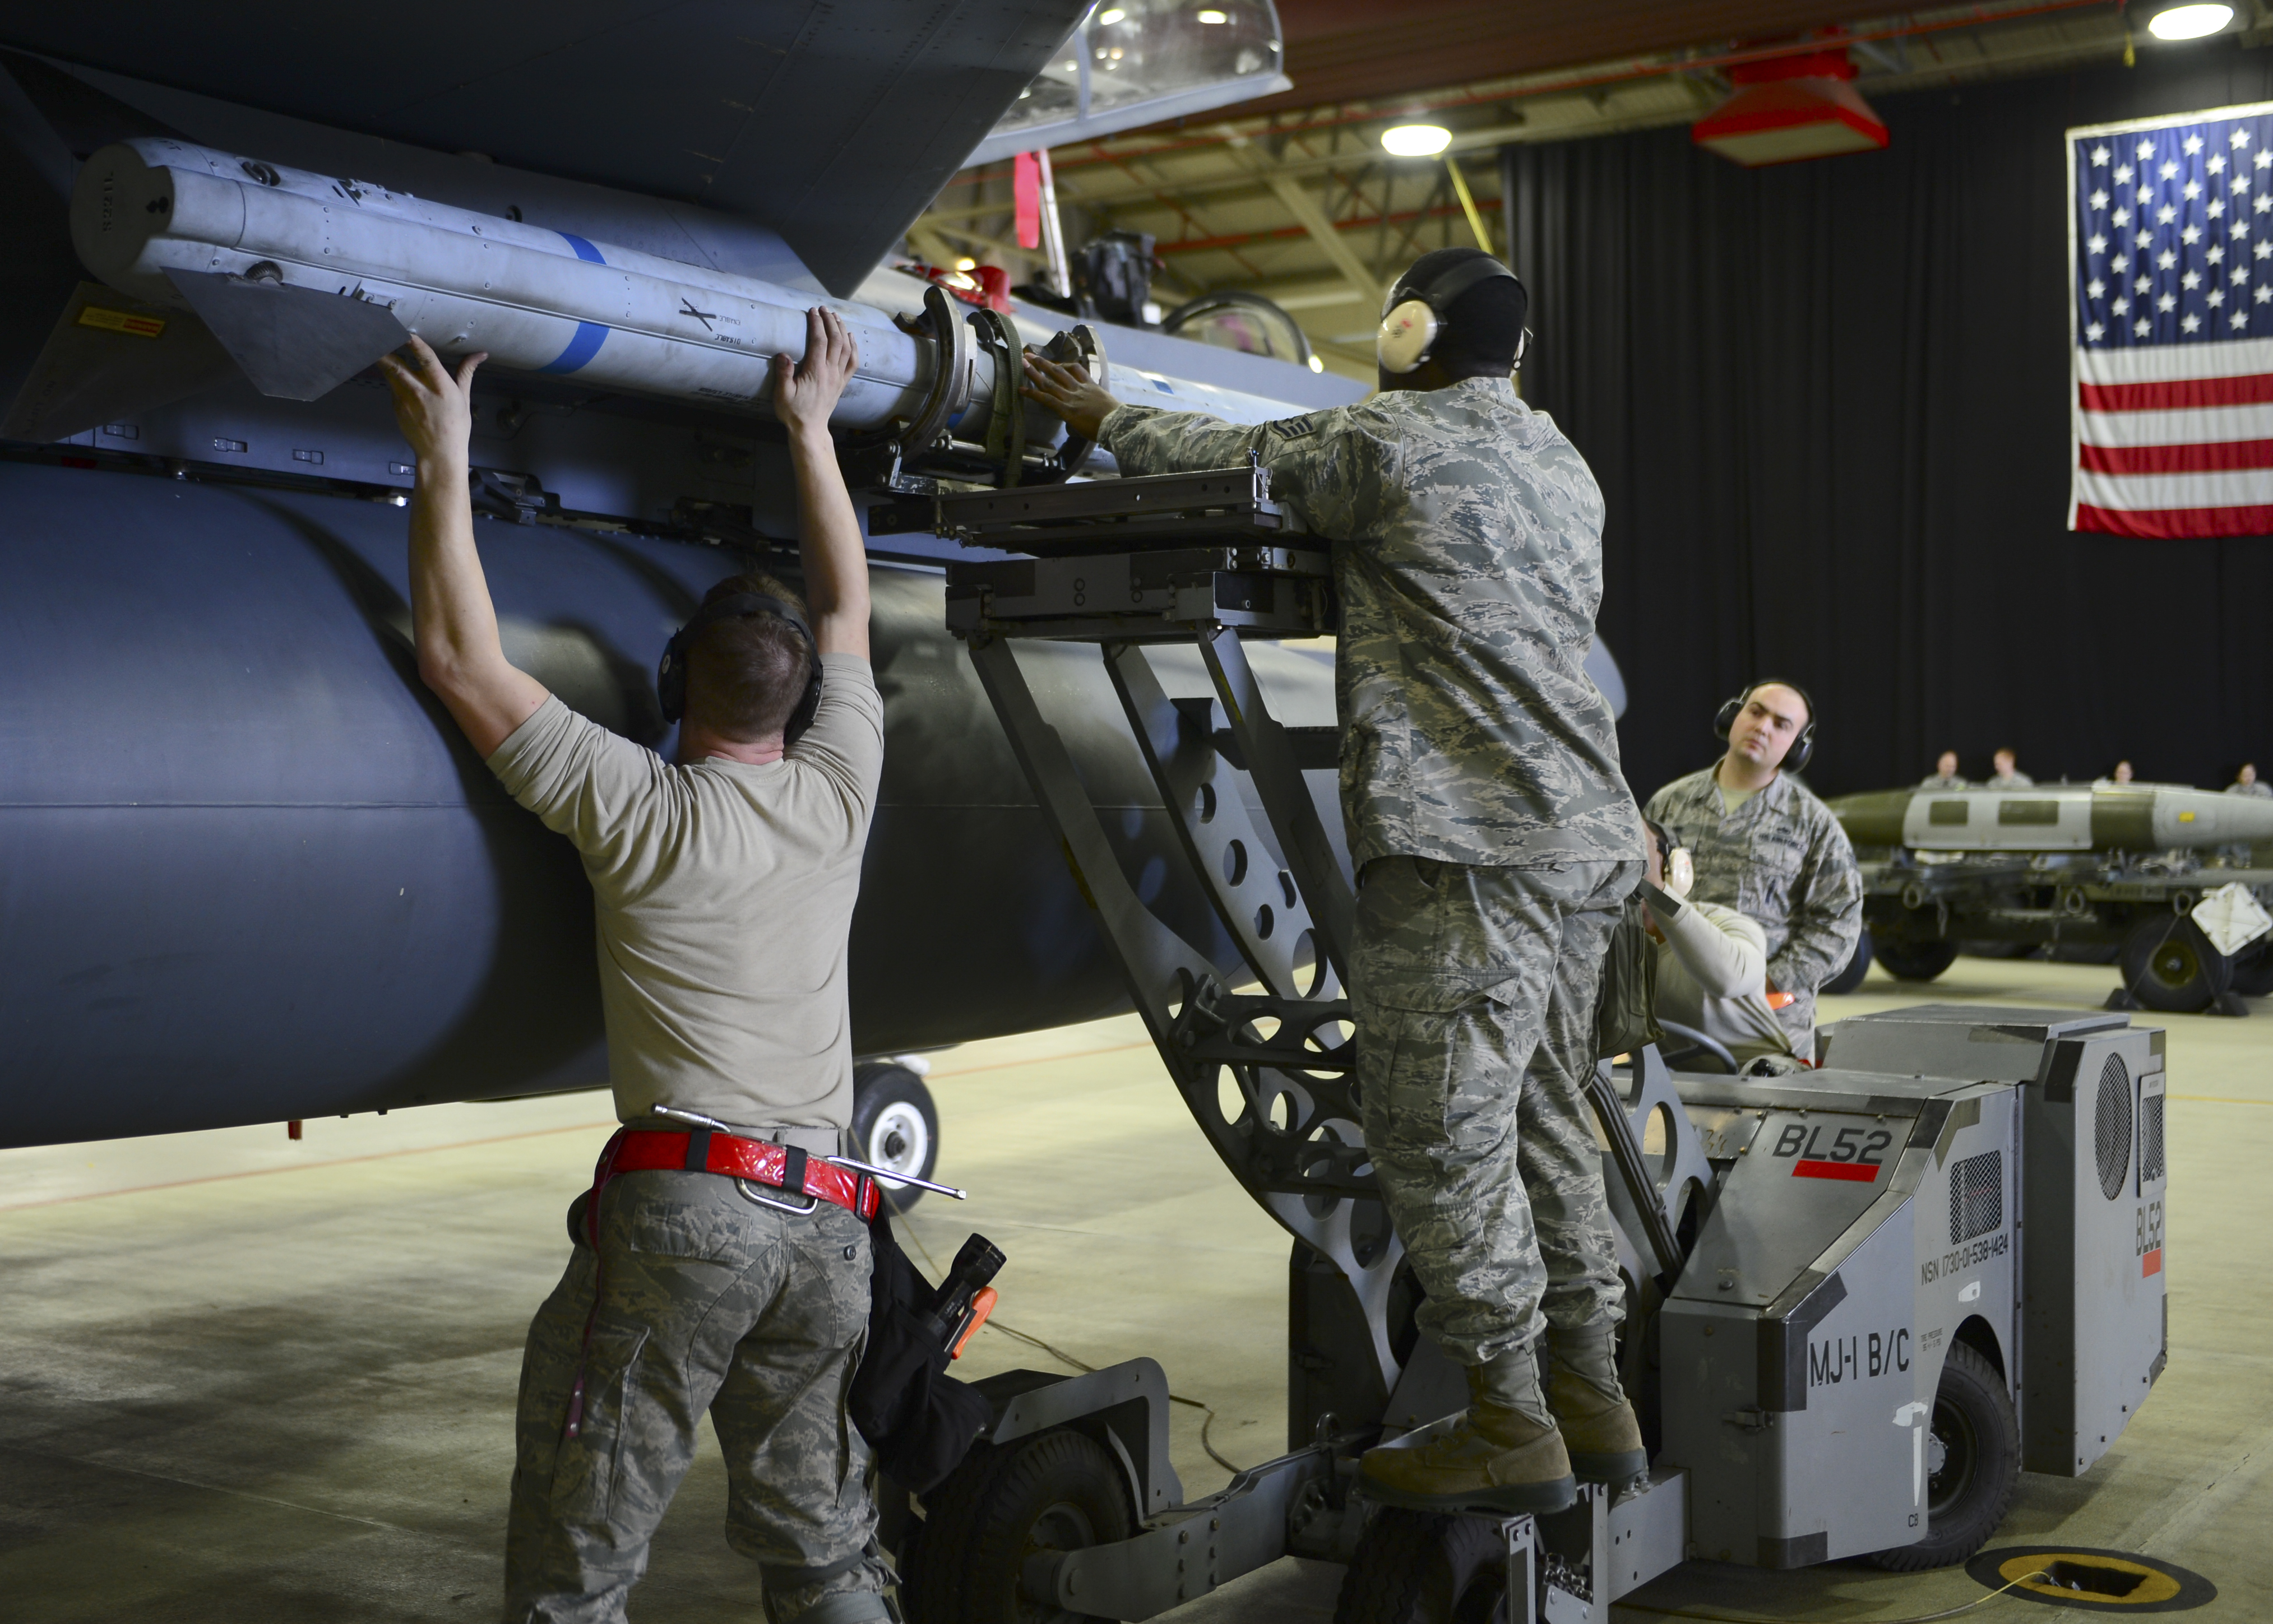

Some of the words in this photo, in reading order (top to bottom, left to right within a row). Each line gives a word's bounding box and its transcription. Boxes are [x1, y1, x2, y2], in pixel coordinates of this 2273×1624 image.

[715, 334, 741, 345] DISABLE
[720, 315, 741, 326] ENABLE
[1772, 1124, 1892, 1164] BL52
[2136, 1201, 2161, 1257] BL52
[1922, 1258, 1939, 1286] NSN
[1942, 1233, 2008, 1277] 1730-01-538-1424
[1810, 1335, 1857, 1388] MJ-1
[1868, 1328, 1910, 1377] B/C
